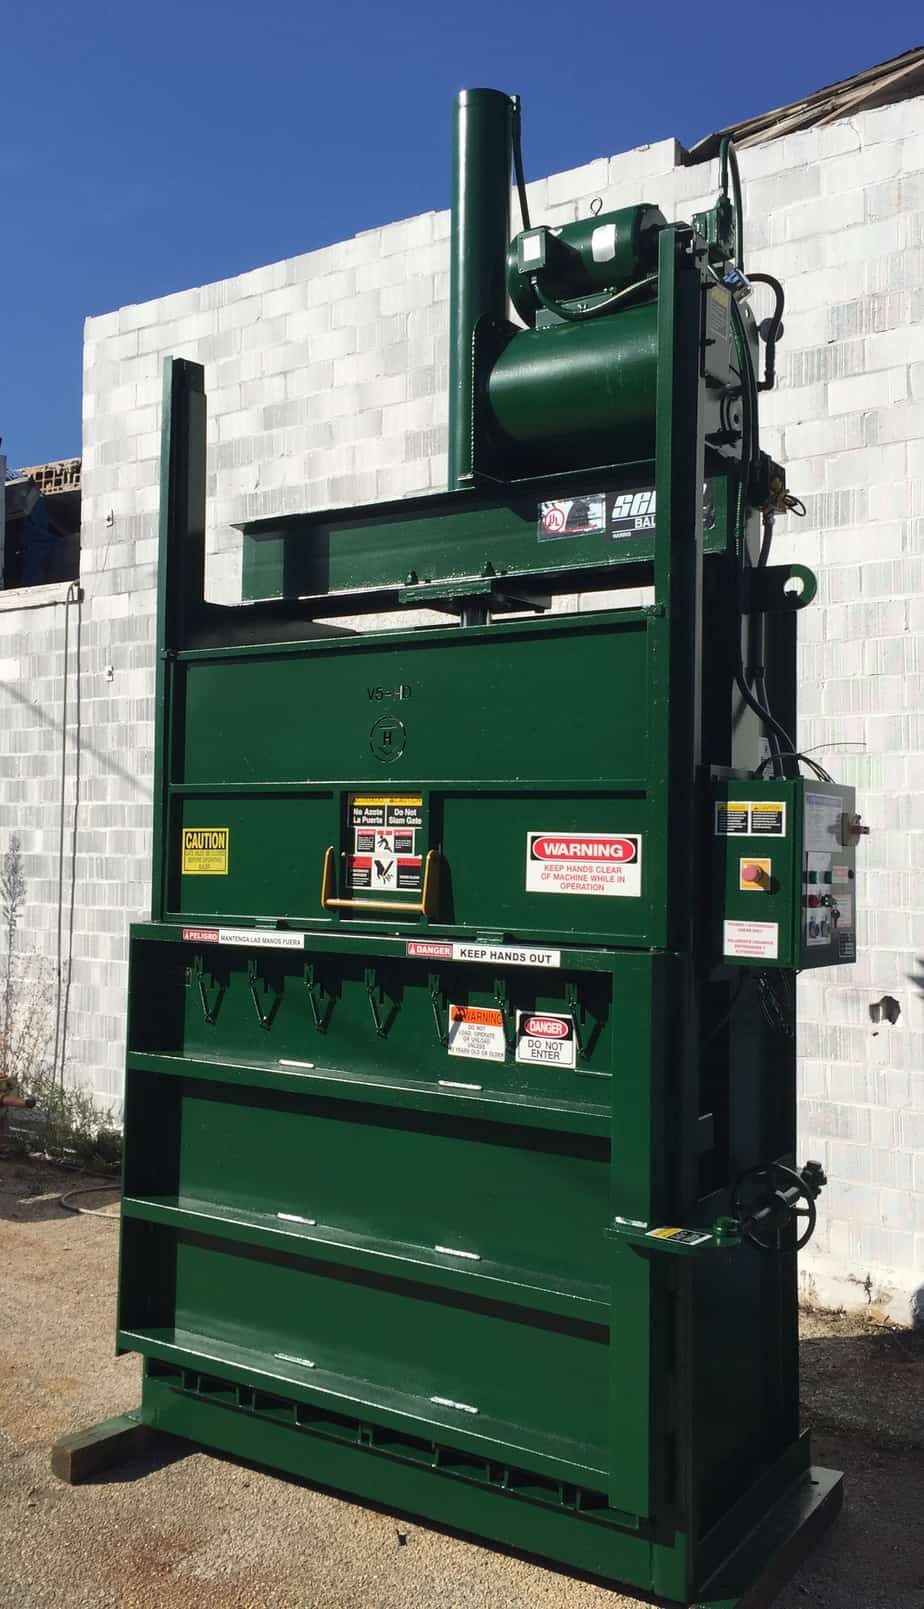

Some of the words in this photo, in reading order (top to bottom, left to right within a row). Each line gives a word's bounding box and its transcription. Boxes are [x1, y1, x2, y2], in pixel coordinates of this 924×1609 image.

[405, 808, 417, 817] Not
[406, 816, 422, 825] Gate
[186, 832, 225, 849] CAUTION
[543, 842, 624, 858] WARNING
[544, 864, 565, 872] KEEP
[566, 865, 594, 873] HANDS
[595, 866, 622, 874] CLEAR
[540, 873, 552, 881] OF
[553, 873, 588, 882] MACHINE
[590, 874, 615, 883] WHILE
[560, 882, 605, 892] OPERATION
[220, 934, 249, 943] MANTENGA
[262, 937, 281, 945] MANOS
[416, 945, 451, 956] DANGER
[460, 948, 487, 959] KEEP
[489, 950, 526, 962] HANDS
[529, 953, 552, 964] OUT
[530, 1020, 563, 1034] DANGER
[528, 1039, 540, 1049] DO
[545, 1041, 564, 1051] NOT
[531, 1048, 561, 1061] ENTER
